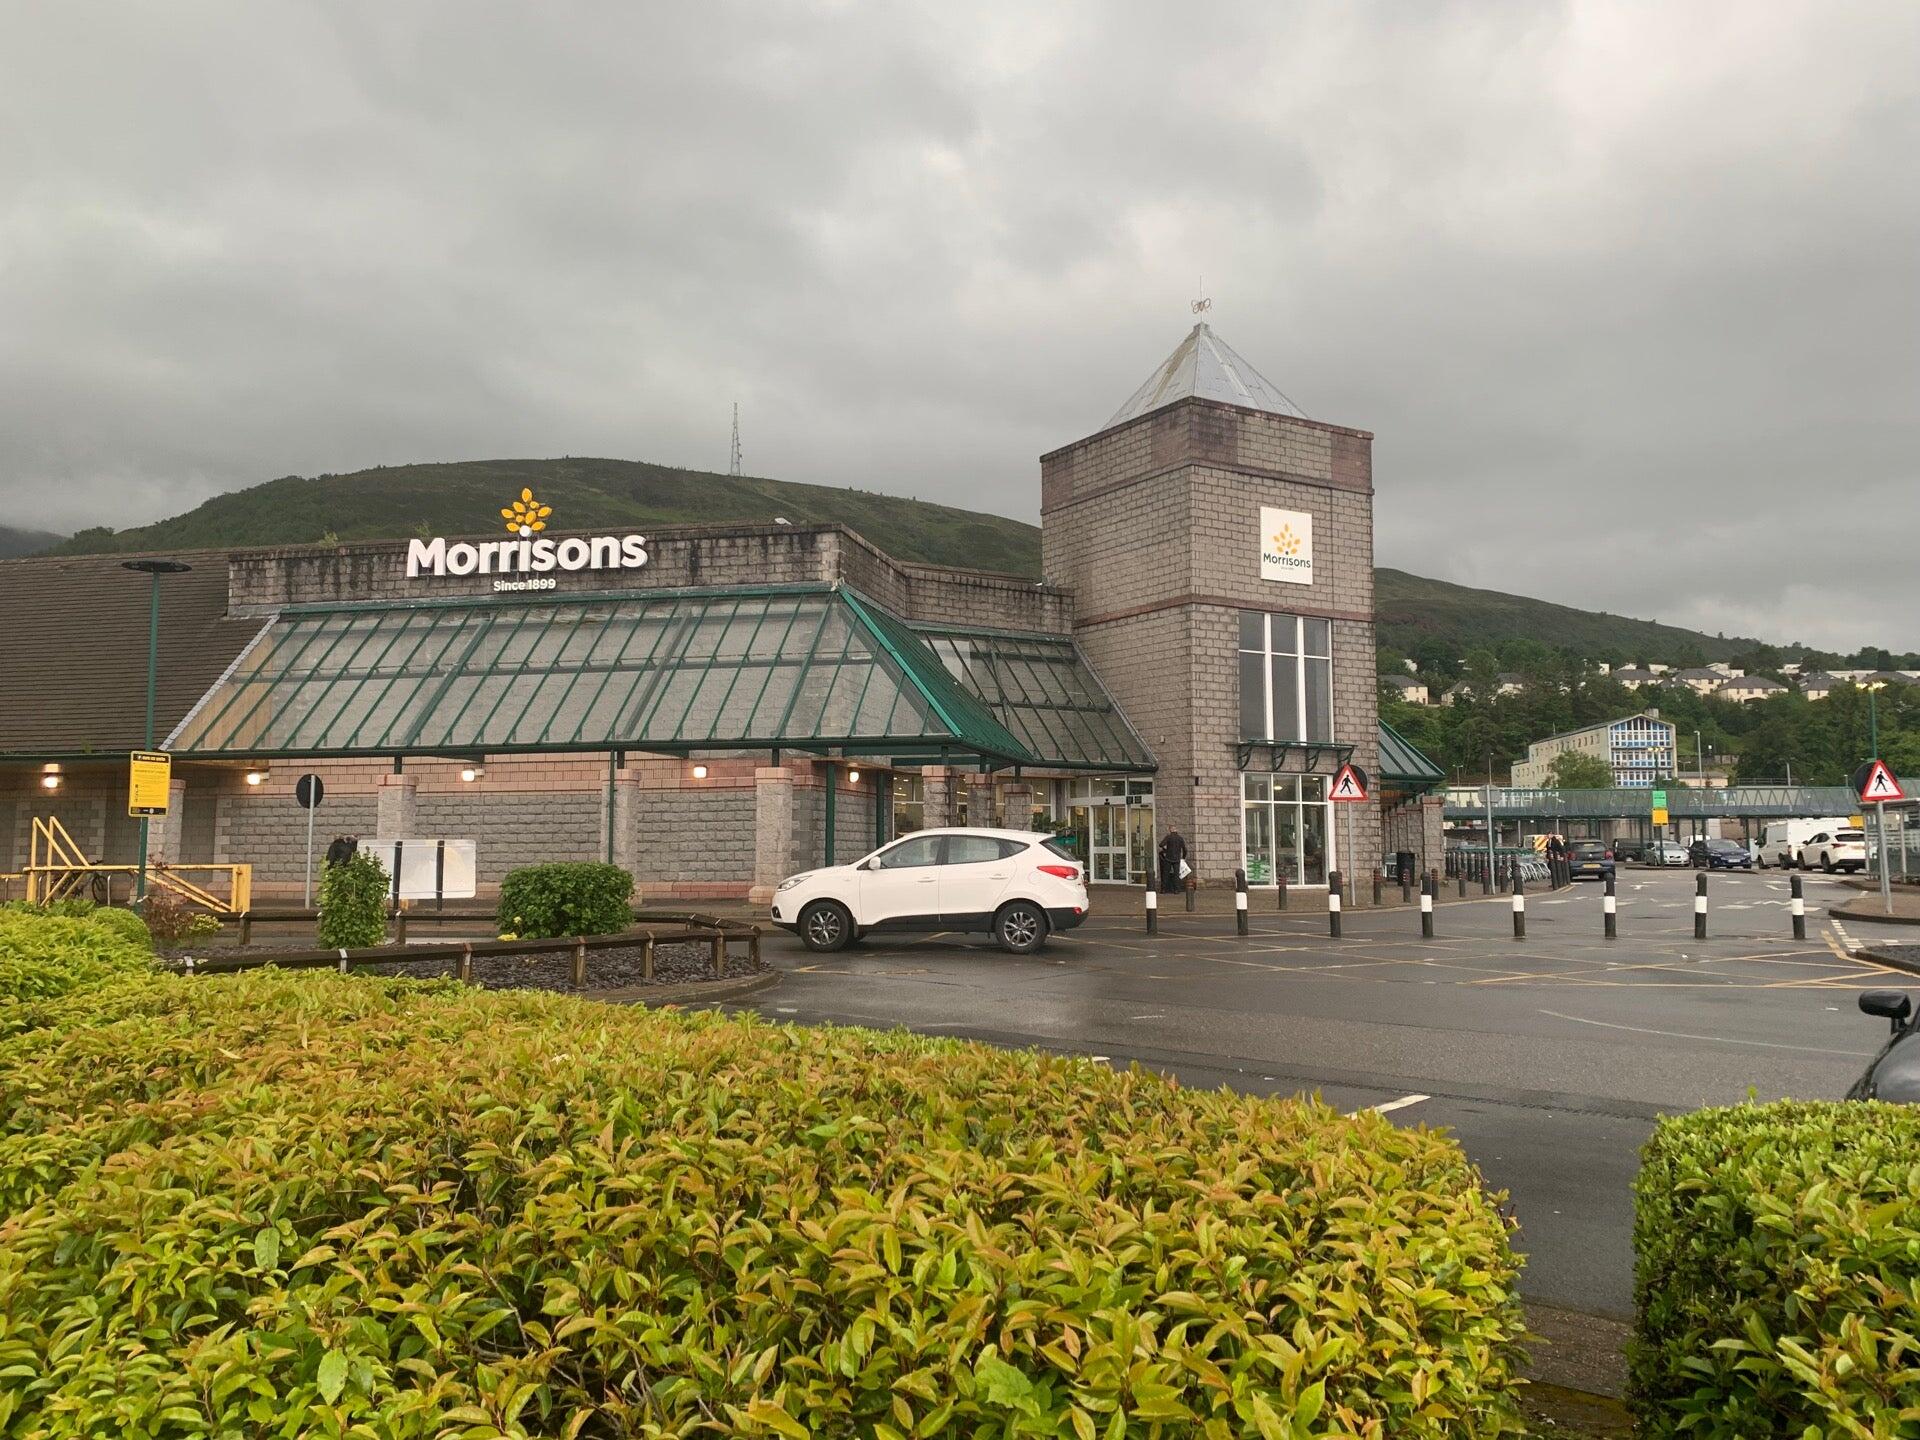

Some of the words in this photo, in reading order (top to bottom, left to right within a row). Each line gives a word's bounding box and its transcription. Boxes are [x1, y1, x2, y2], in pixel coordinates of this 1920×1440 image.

[406, 527, 648, 577] Morrisons
[1263, 552, 1311, 568] Morrisons
[493, 580, 526, 592] Since
[527, 578, 556, 590] 1899
